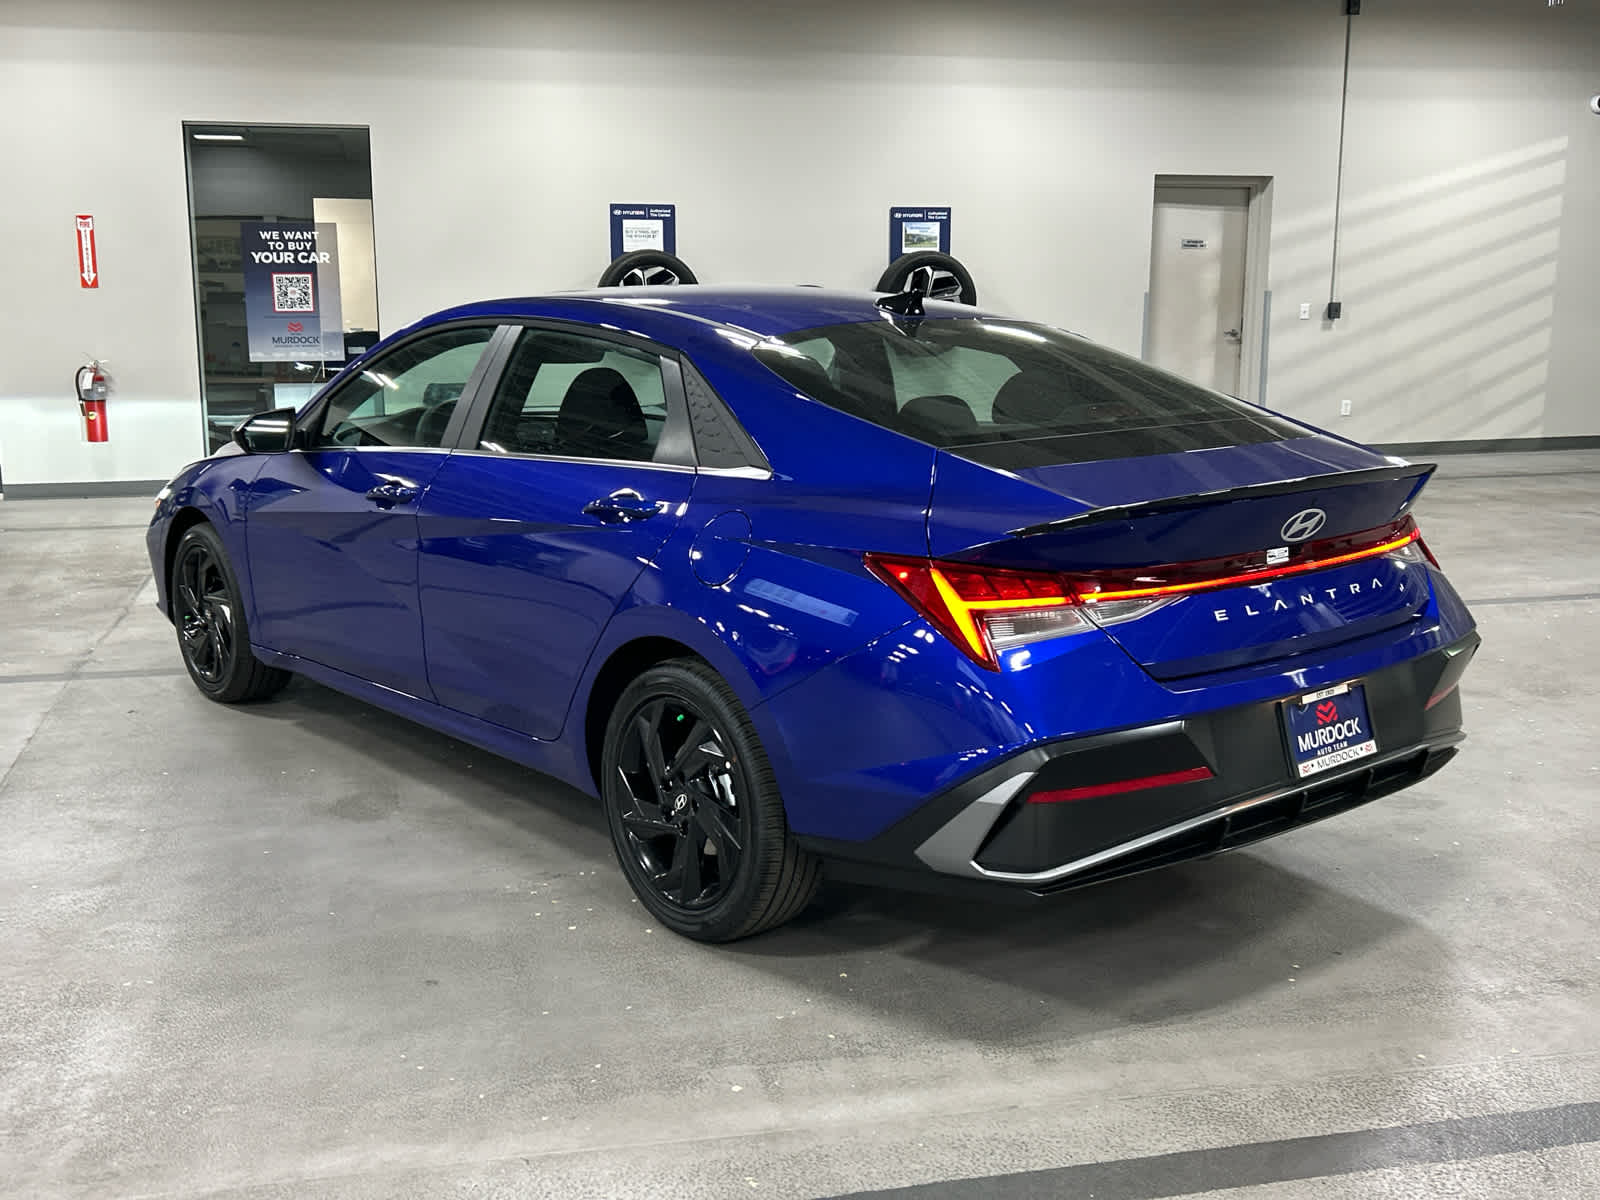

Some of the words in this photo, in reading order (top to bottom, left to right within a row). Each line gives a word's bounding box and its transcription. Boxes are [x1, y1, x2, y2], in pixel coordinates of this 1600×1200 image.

[259, 231, 280, 240] WE
[283, 231, 319, 240] WANT
[268, 241, 285, 250] TO
[287, 241, 312, 250] BUY
[251, 252, 295, 264] YOUR
[297, 252, 330, 264] CAR
[272, 336, 320, 344] MURDOCK
[1214, 578, 1382, 622] ELANTRA
[1297, 717, 1362, 753] MURDOCK
[1317, 746, 1333, 756] AUTO
[1333, 741, 1348, 751] TEAM
[1316, 748, 1360, 769] MURDOCK
